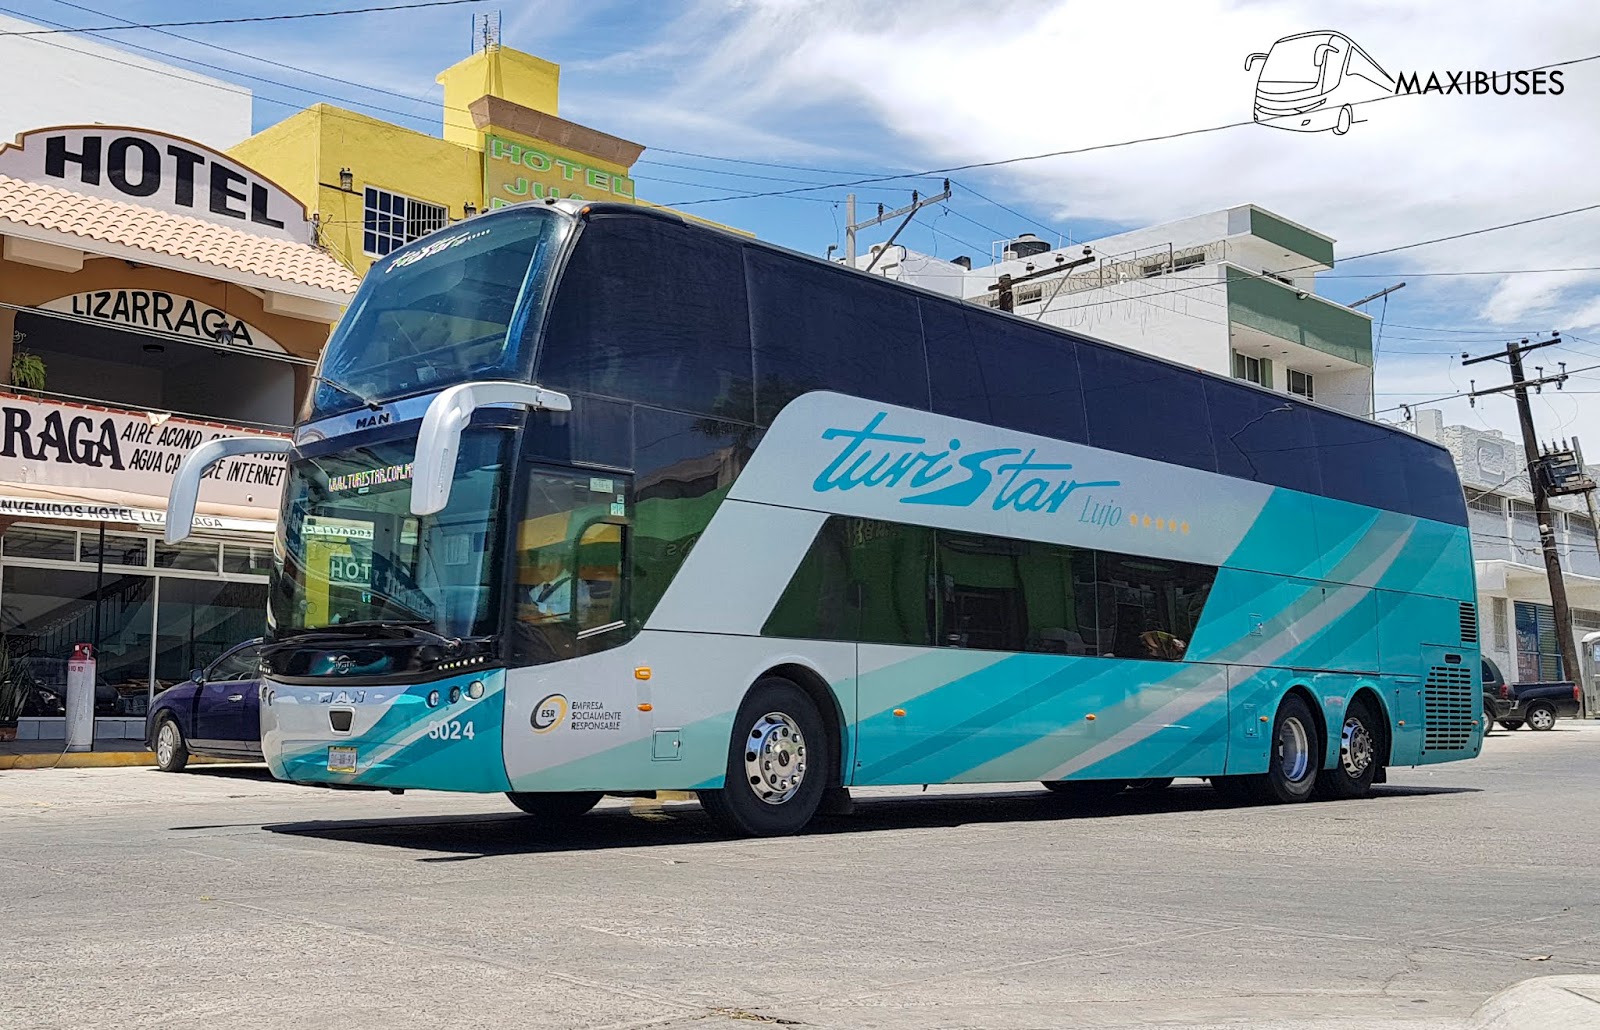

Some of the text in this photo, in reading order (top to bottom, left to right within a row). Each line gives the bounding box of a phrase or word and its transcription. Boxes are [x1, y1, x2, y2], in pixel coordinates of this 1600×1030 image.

[490, 138, 634, 198] HOTEL
[45, 135, 285, 230] HOTEL
[72, 291, 254, 346] LIZARRAGA
[355, 412, 390, 429] MAN
[120, 421, 155, 445] AIRE
[129, 448, 161, 473] AGUA
[226, 460, 287, 487] INTERNET
[0, 499, 84, 518] NVENIDOS
[87, 506, 137, 522] HOTEL
[1077, 494, 1123, 531] Lujo
[541, 709, 556, 718] ESR
[571, 701, 604, 710] EMPRESA
[571, 711, 622, 721] SOCIALMENTE
[571, 721, 621, 731] RESPONSABLE
